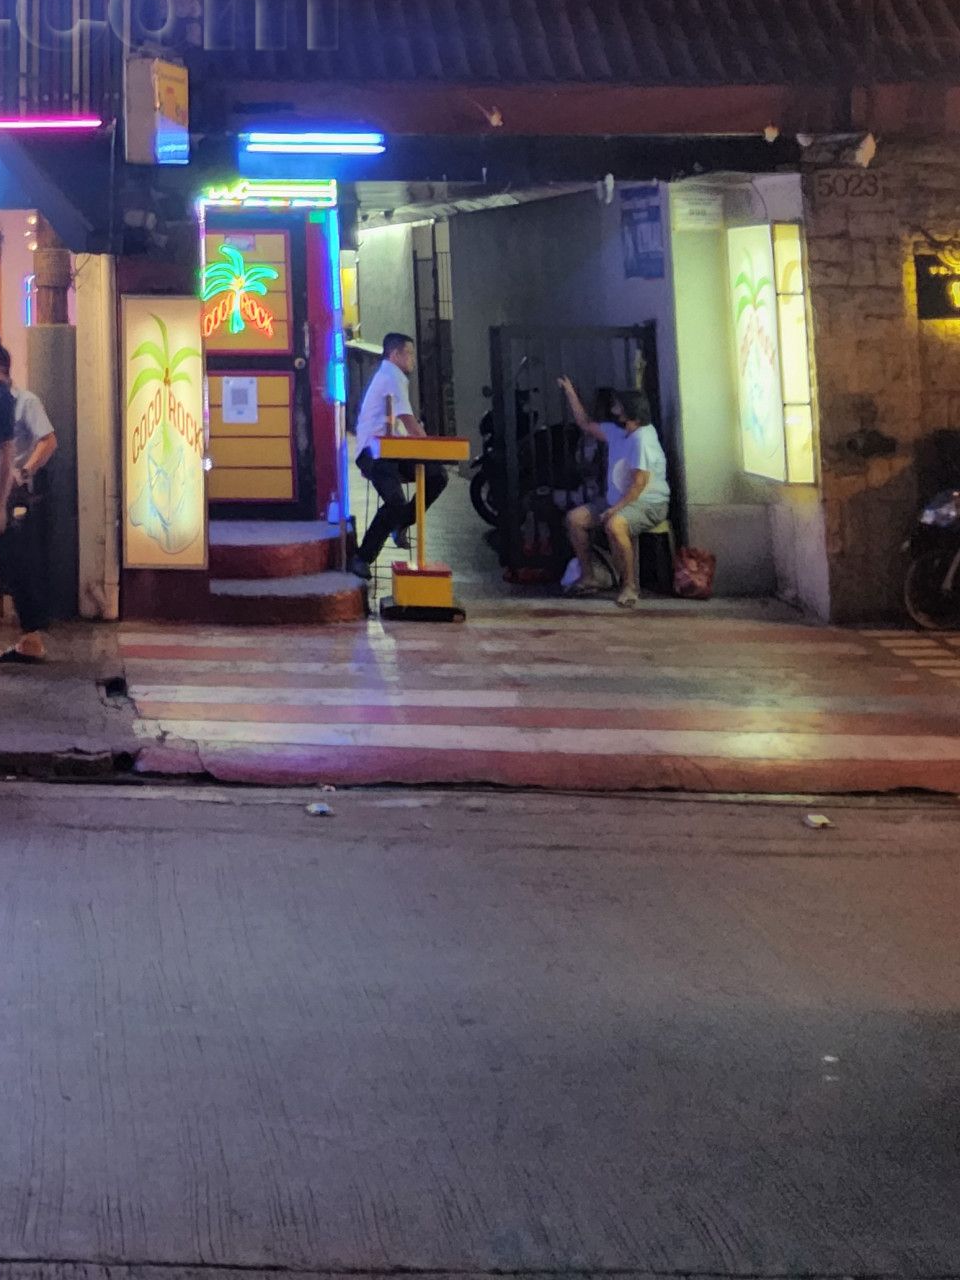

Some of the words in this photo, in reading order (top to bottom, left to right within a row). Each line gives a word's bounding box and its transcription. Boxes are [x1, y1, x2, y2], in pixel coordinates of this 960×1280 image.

[816, 174, 879, 197] 5023
[204, 291, 237, 337] COCO
[240, 293, 274, 337] ROCK
[132, 388, 162, 464] COCO
[168, 390, 204, 458] ROCK
